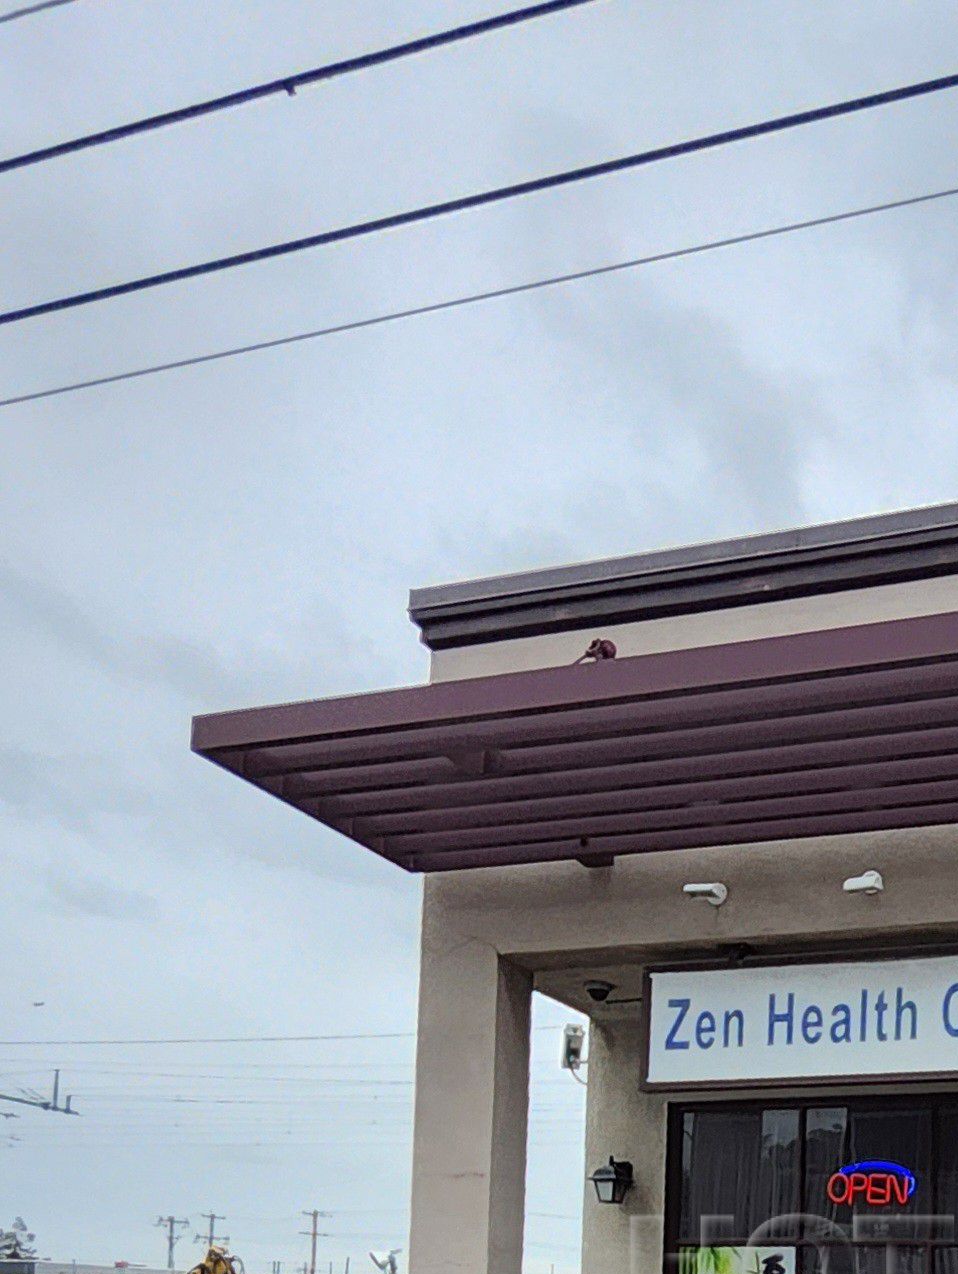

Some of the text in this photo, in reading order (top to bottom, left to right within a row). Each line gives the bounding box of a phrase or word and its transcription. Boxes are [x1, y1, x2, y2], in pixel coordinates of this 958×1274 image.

[664, 998, 745, 1050] Zen
[766, 987, 918, 1046] Health
[826, 1172, 909, 1206] OPEN
